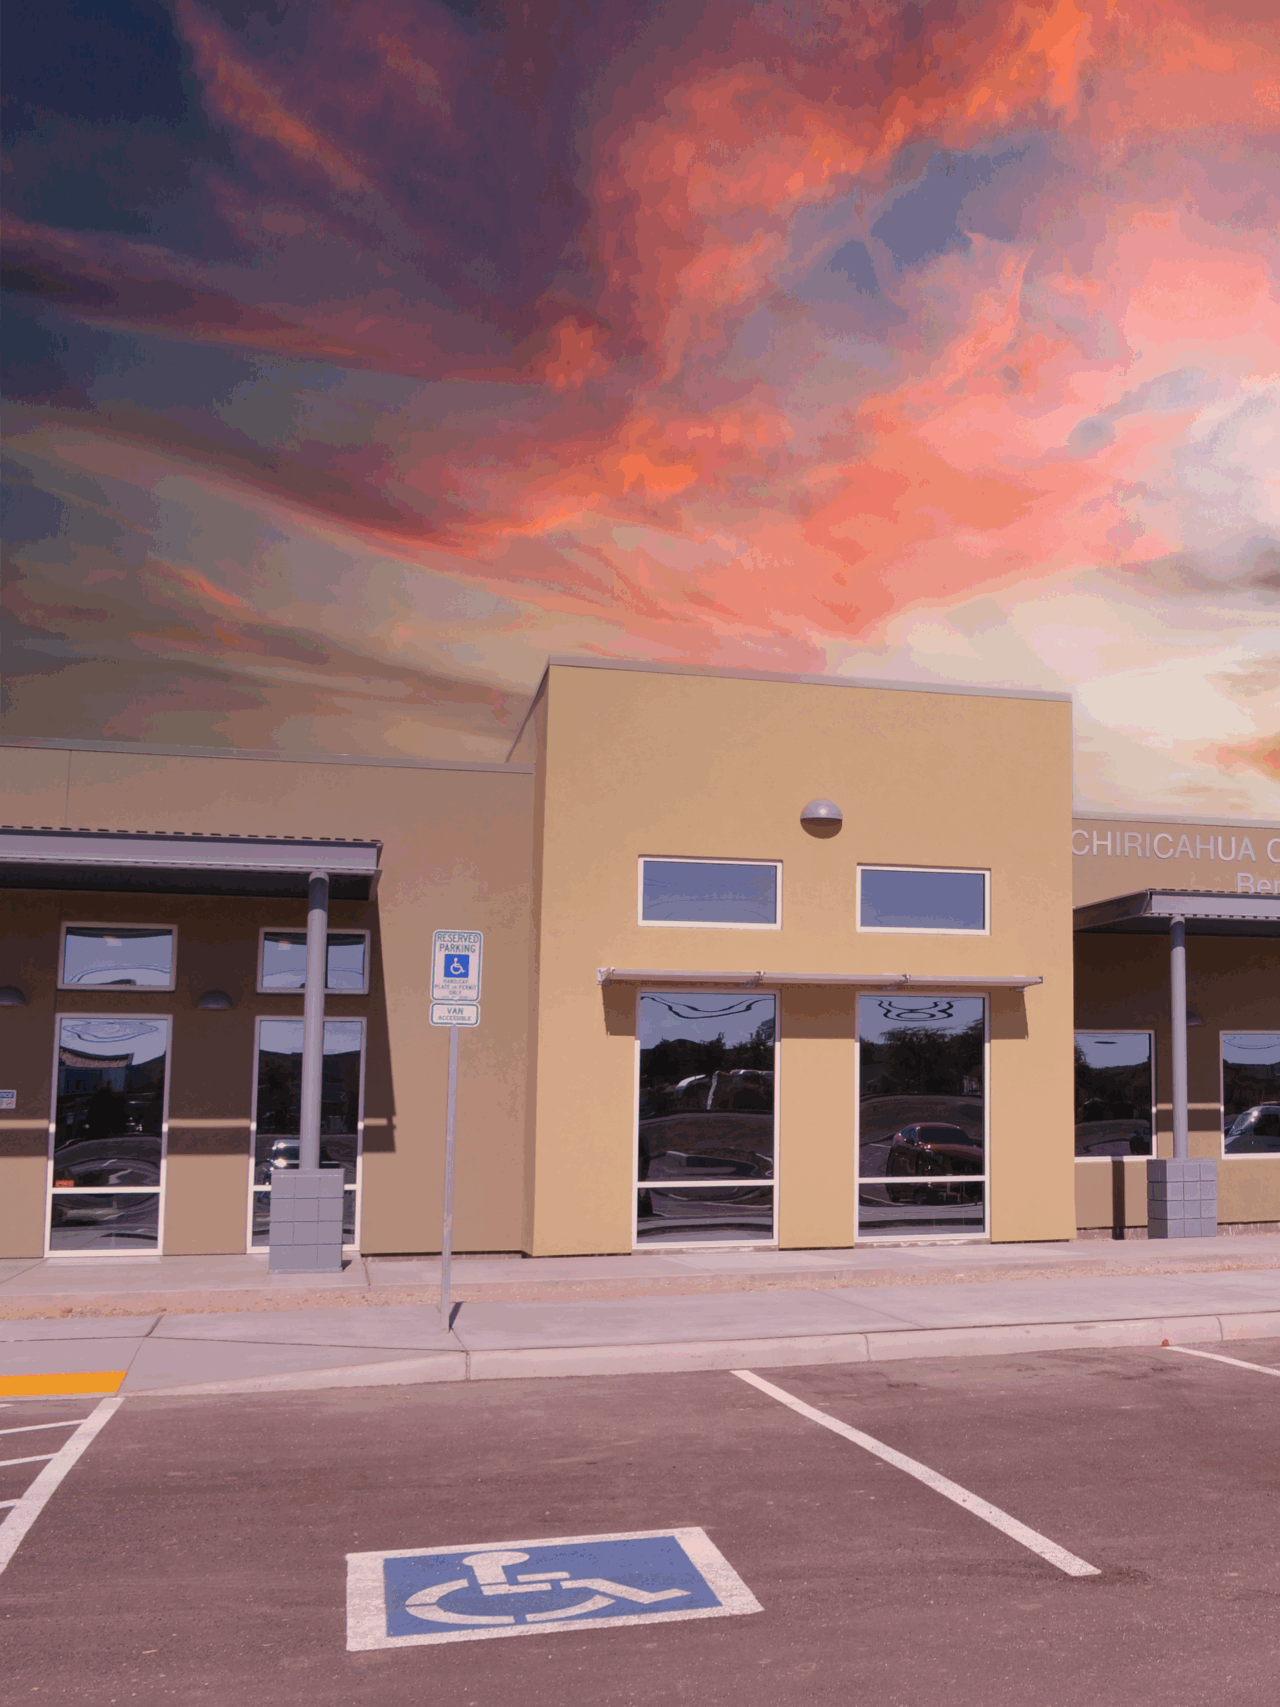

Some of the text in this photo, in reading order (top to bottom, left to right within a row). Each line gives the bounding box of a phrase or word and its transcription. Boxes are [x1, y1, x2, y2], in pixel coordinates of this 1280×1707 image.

[1071, 829, 1256, 862] CHIRICAHUA
[437, 933, 479, 944] RESERVED
[439, 943, 476, 953] PARKING
[446, 1007, 464, 1015] VAN
